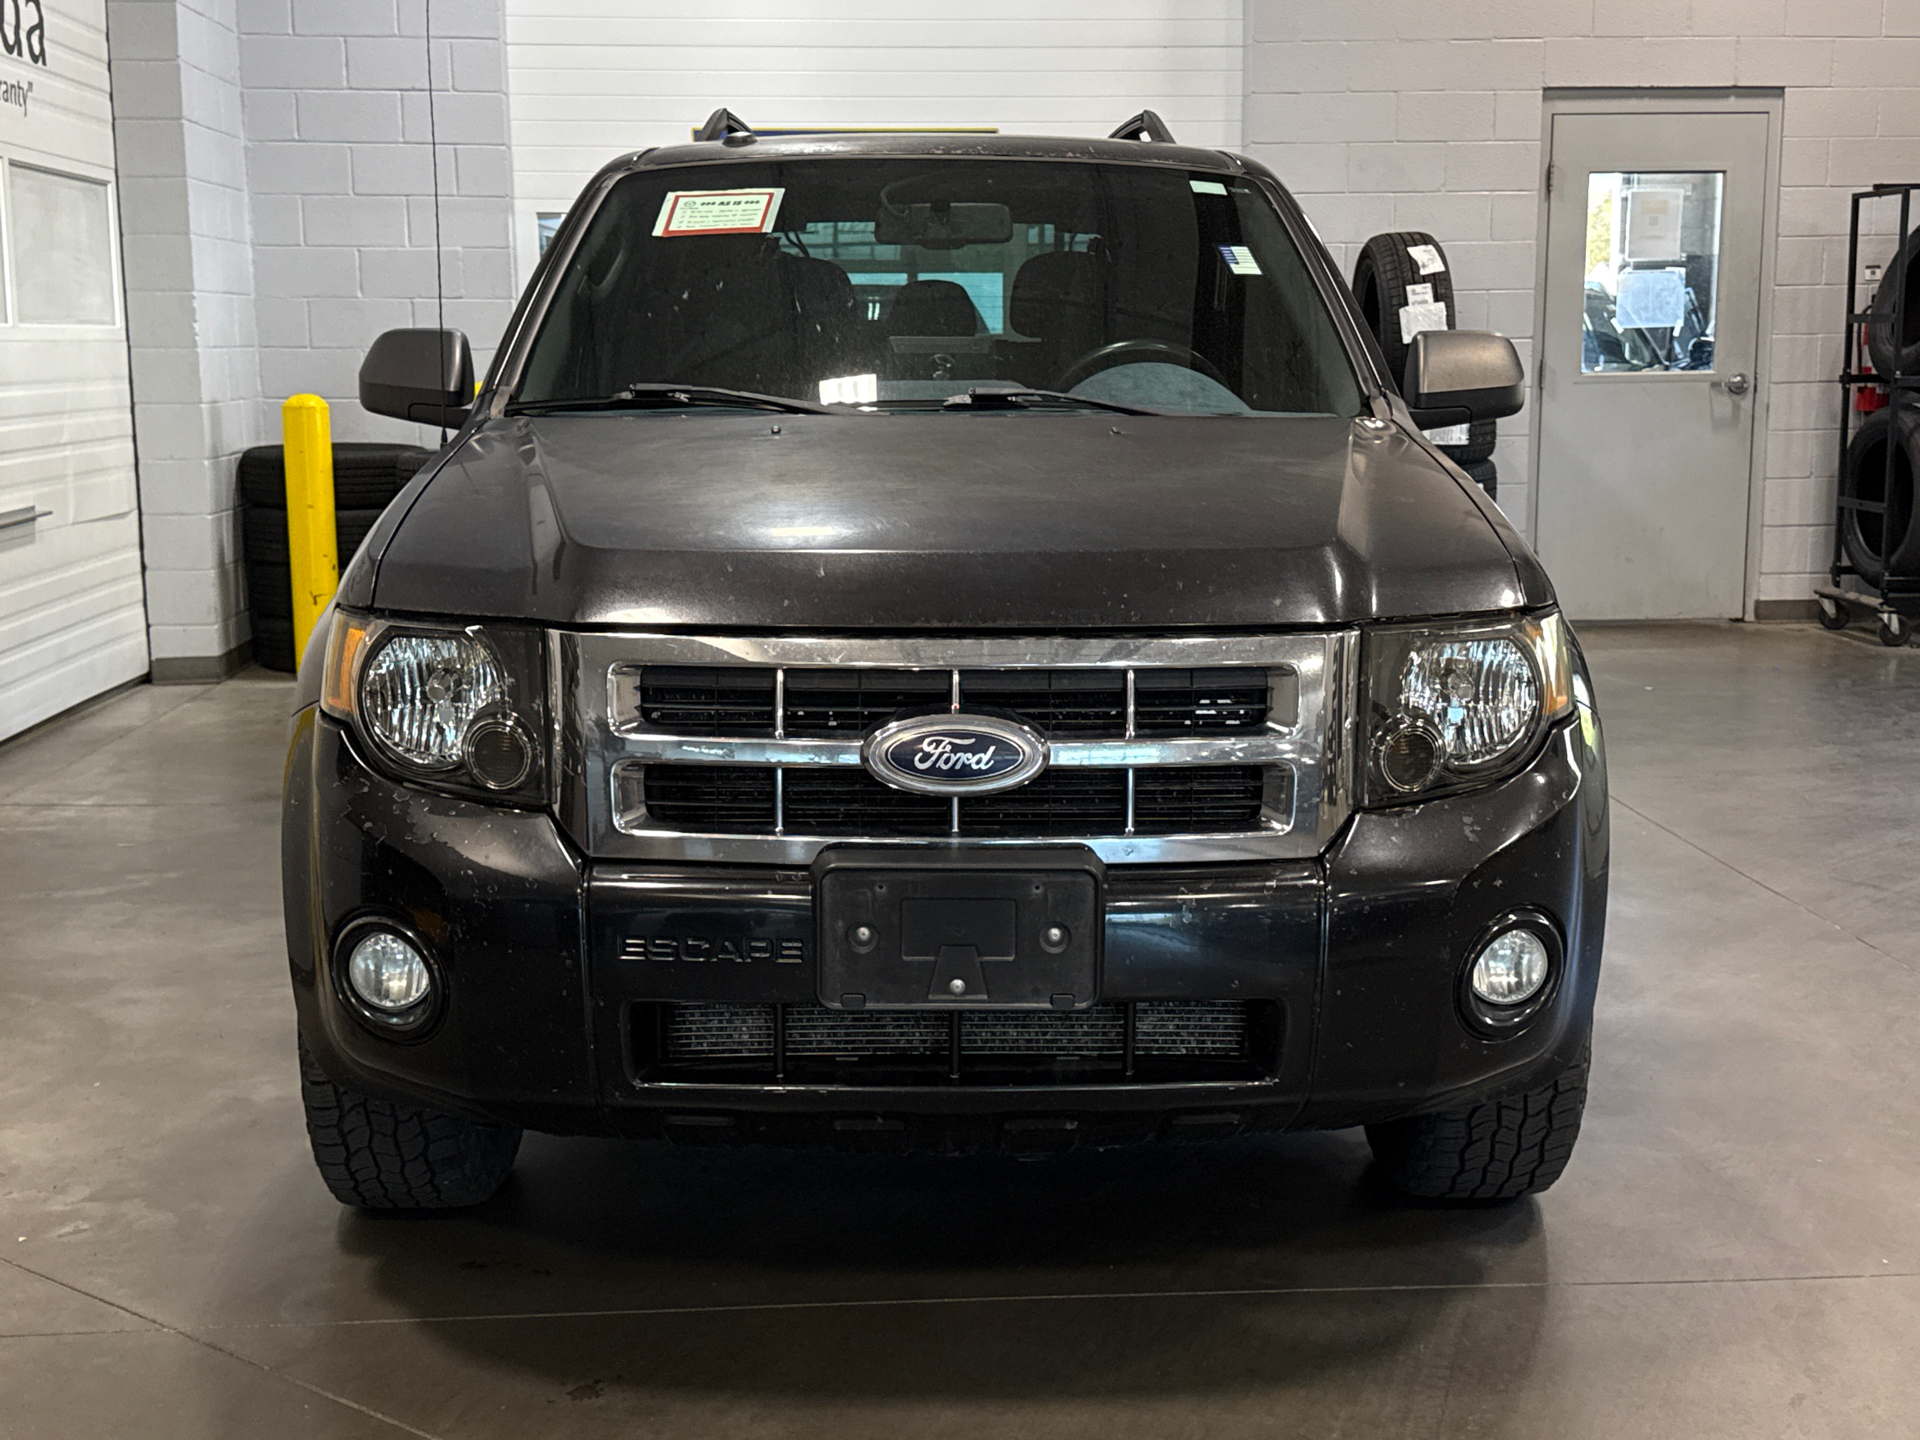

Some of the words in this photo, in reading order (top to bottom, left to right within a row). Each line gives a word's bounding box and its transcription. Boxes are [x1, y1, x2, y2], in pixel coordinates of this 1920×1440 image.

[0, 80, 33, 118] anty"
[914, 736, 996, 770] Ford
[617, 937, 802, 963] ESCAPE
